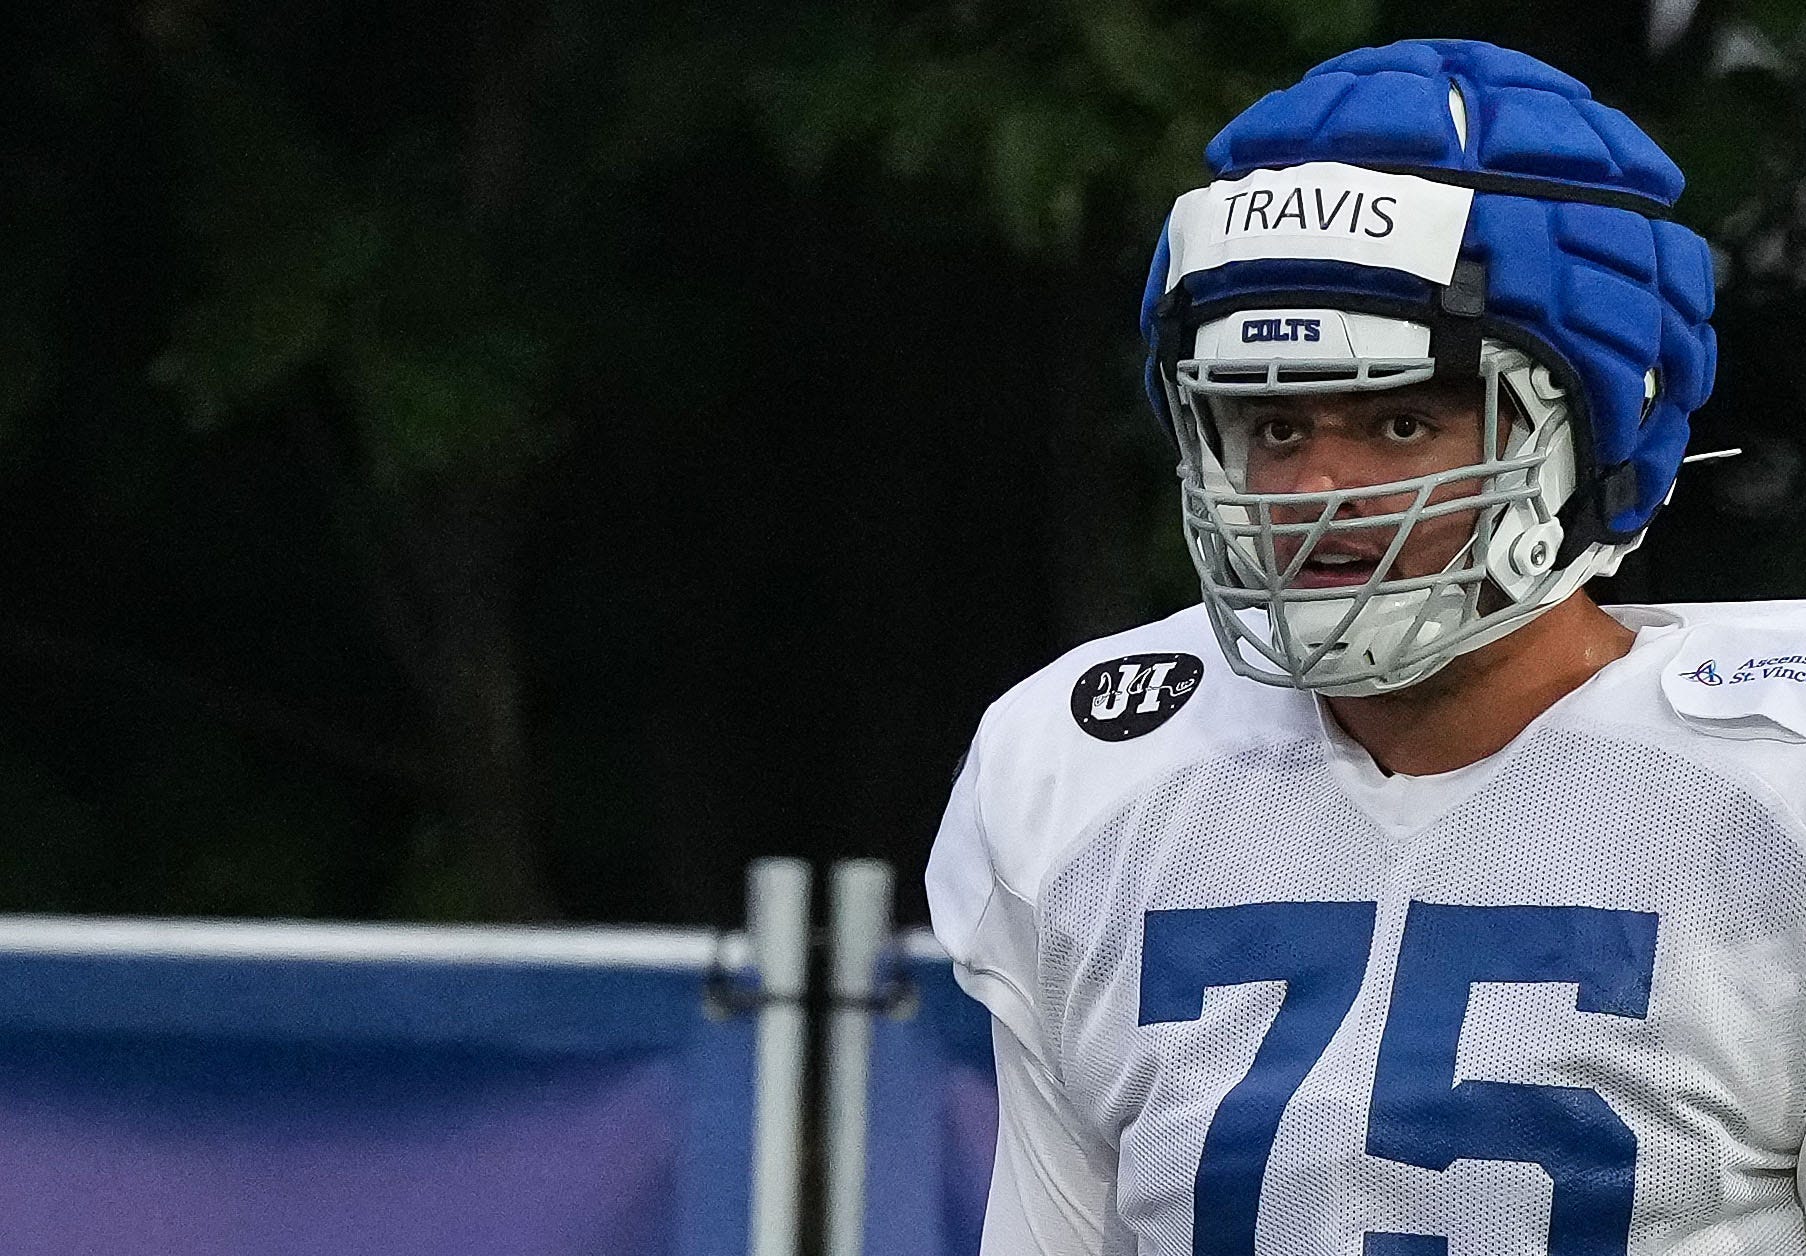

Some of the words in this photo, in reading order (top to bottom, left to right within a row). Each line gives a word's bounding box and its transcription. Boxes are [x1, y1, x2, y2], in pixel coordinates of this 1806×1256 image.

[1224, 187, 1397, 238] TRAVIS
[1241, 318, 1321, 343] COLTS
[1728, 671, 1756, 685] St.
